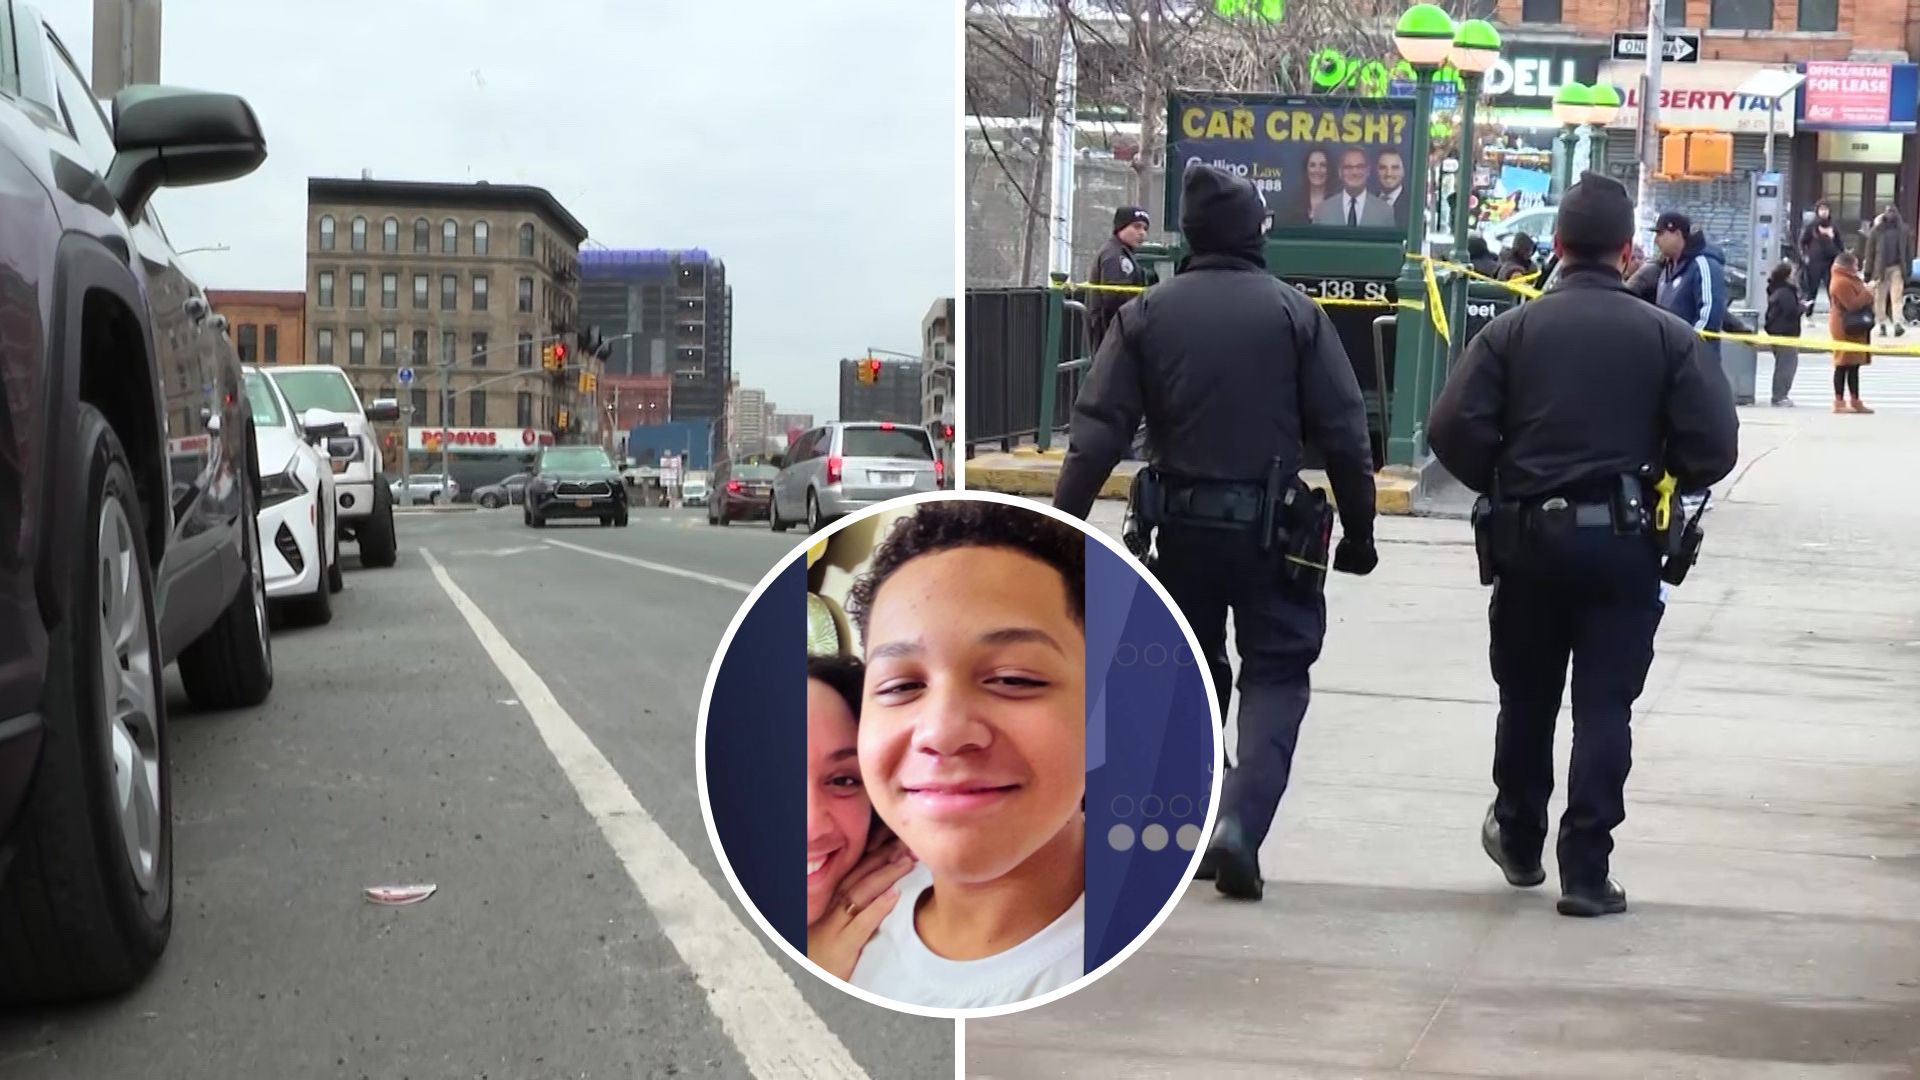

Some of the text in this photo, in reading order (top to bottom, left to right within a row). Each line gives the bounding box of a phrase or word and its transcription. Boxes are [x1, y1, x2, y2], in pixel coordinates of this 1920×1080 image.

[1808, 79, 1888, 93] FOR LEASE
[1182, 107, 1407, 144] CAR CRASH?
[1252, 162, 1282, 177] Law
